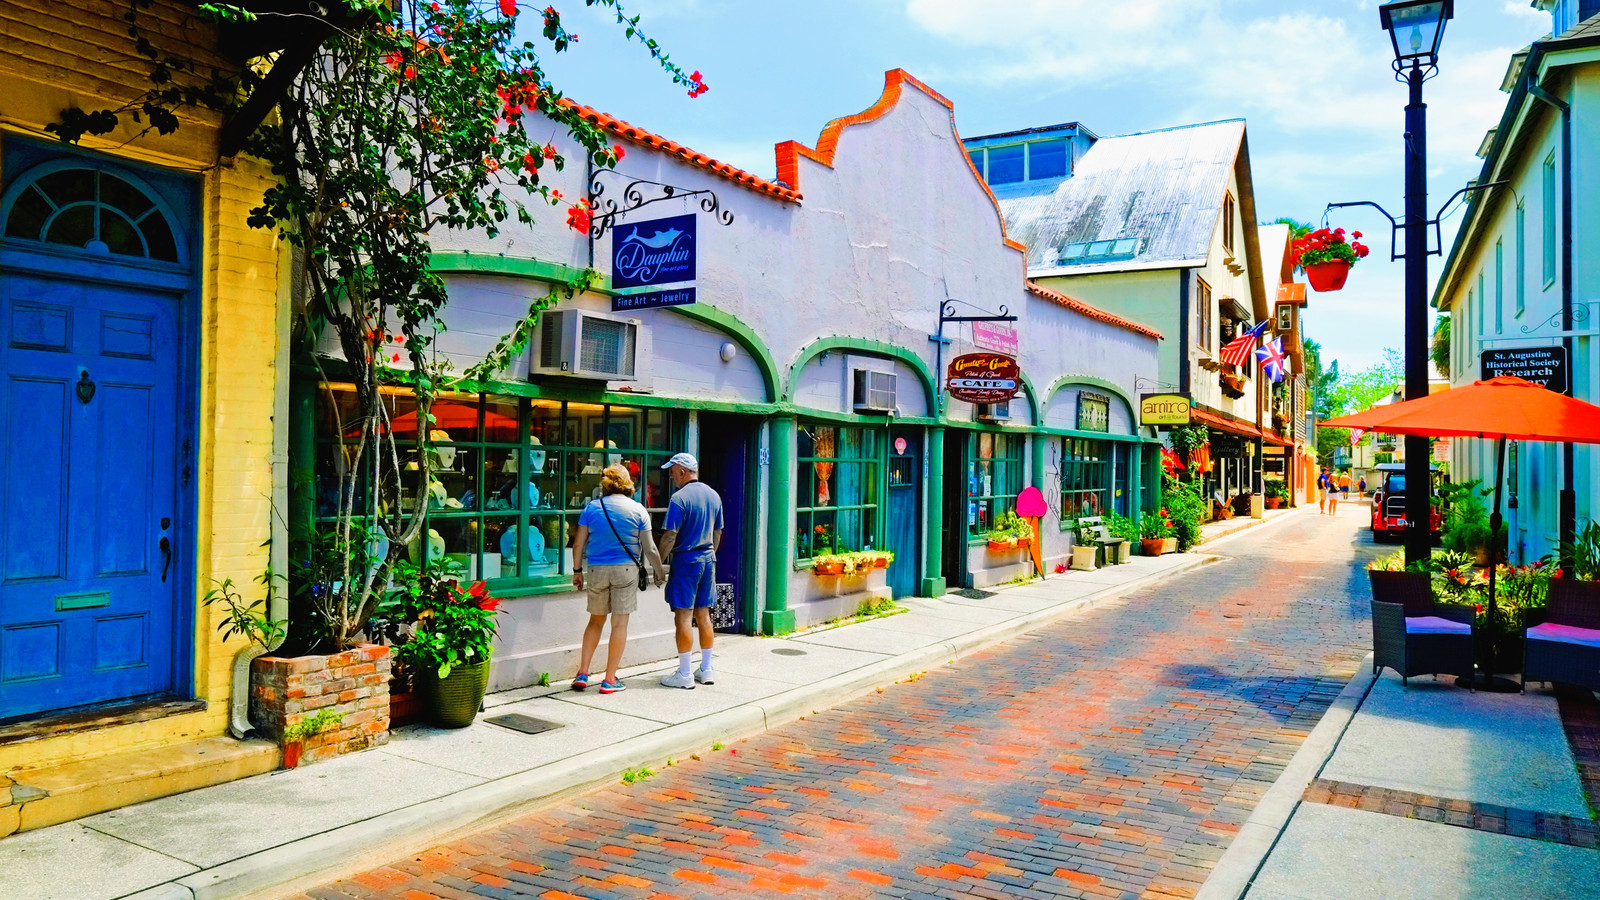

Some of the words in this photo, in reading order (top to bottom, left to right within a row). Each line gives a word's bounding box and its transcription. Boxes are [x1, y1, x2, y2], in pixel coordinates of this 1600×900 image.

[616, 234, 691, 282] Dauphin
[617, 298, 632, 307] Fine
[634, 296, 646, 304] Art
[660, 291, 690, 303] Jewelry
[1494, 352, 1506, 360] St.
[1508, 351, 1552, 360] Augustine
[1486, 360, 1527, 368] Historical
[1530, 359, 1560, 367] Society
[1143, 400, 1188, 413] amiro
